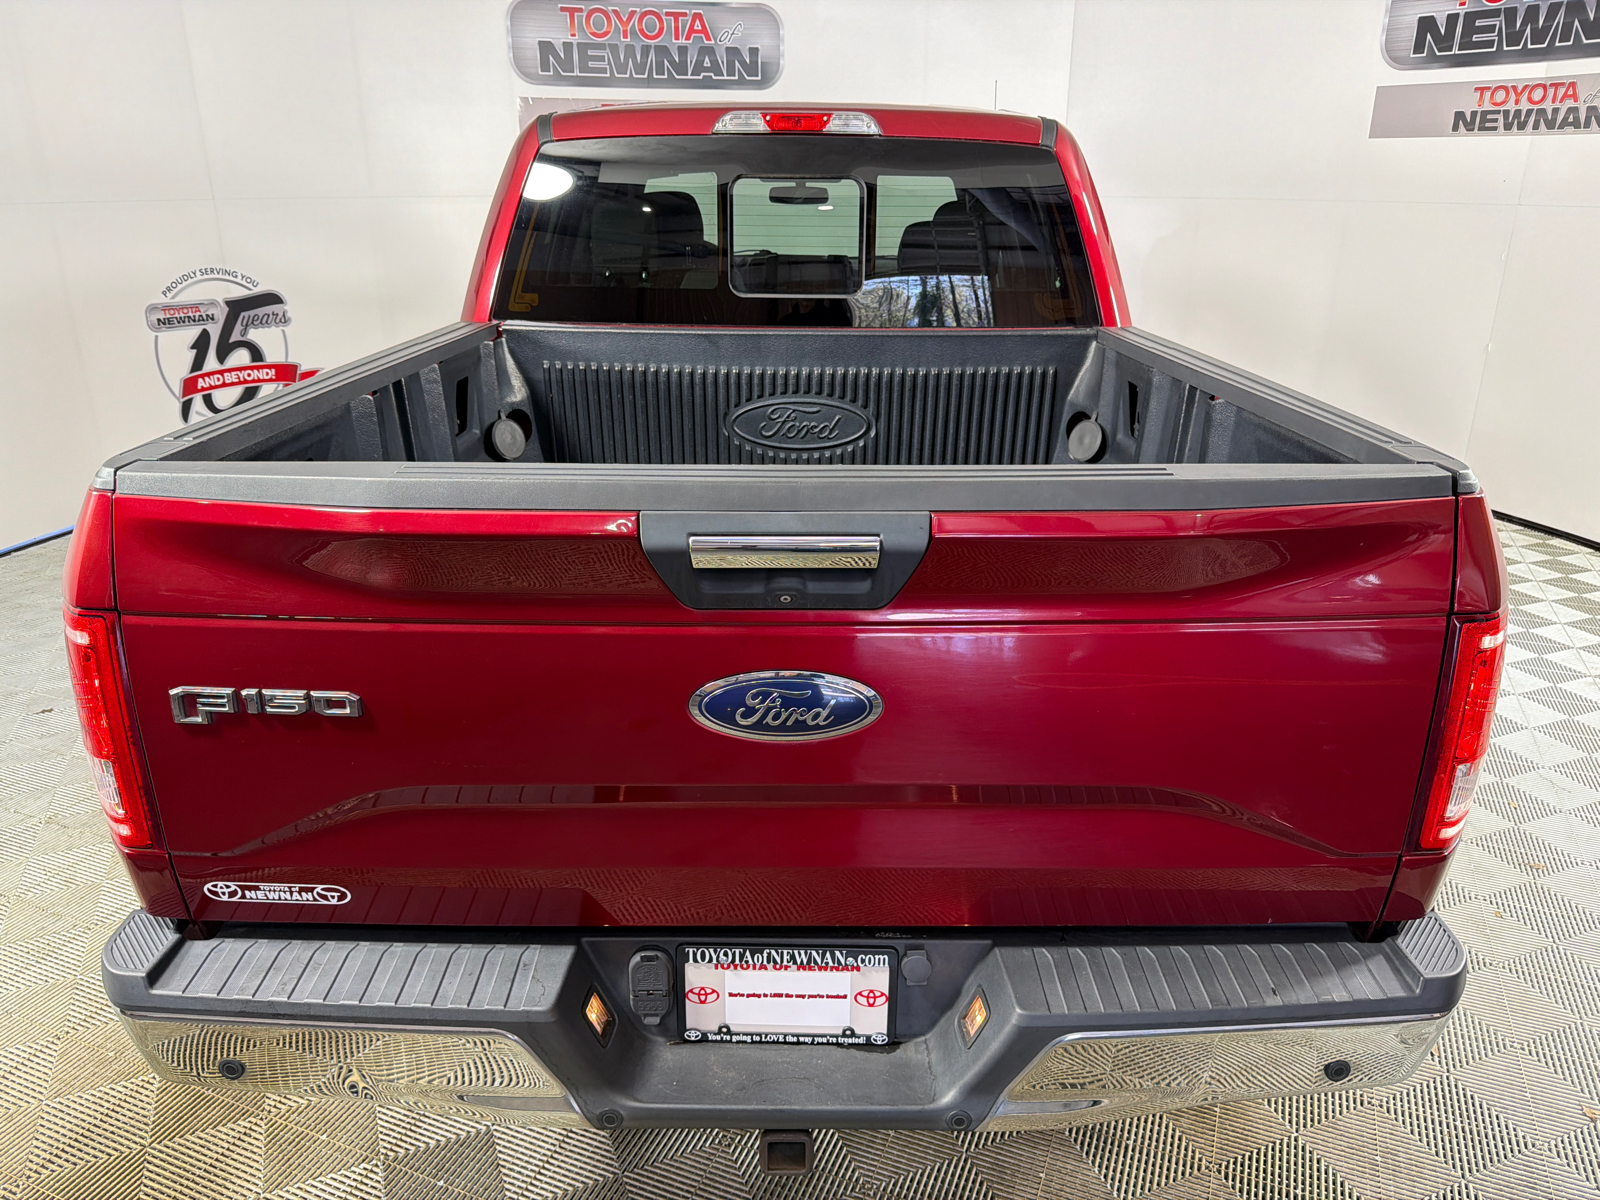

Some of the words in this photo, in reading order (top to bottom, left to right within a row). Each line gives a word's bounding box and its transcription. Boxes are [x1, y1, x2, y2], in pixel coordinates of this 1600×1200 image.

[559, 4, 713, 43] TOYOTA
[718, 22, 743, 44] of
[537, 40, 762, 80] NEWNAN
[1474, 80, 1579, 108] TOYOTA
[161, 269, 198, 298] PROUDLY
[198, 267, 239, 280] SERVING
[240, 272, 260, 288] YOU
[156, 313, 216, 327] NEWNAN
[161, 306, 202, 317] TOYOTA
[241, 310, 290, 338] years
[197, 374, 223, 389] AND
[225, 368, 276, 384] BEYOND!
[759, 404, 841, 439] Ford
[735, 688, 837, 727] Ford
[244, 890, 314, 901] NEWNAN
[707, 1033, 731, 1041] You're
[732, 1034, 751, 1042] going
[762, 1034, 784, 1042] LOVE
[799, 1036, 812, 1044] way
[814, 1036, 836, 1044] you're
[838, 1036, 866, 1044] treated!
